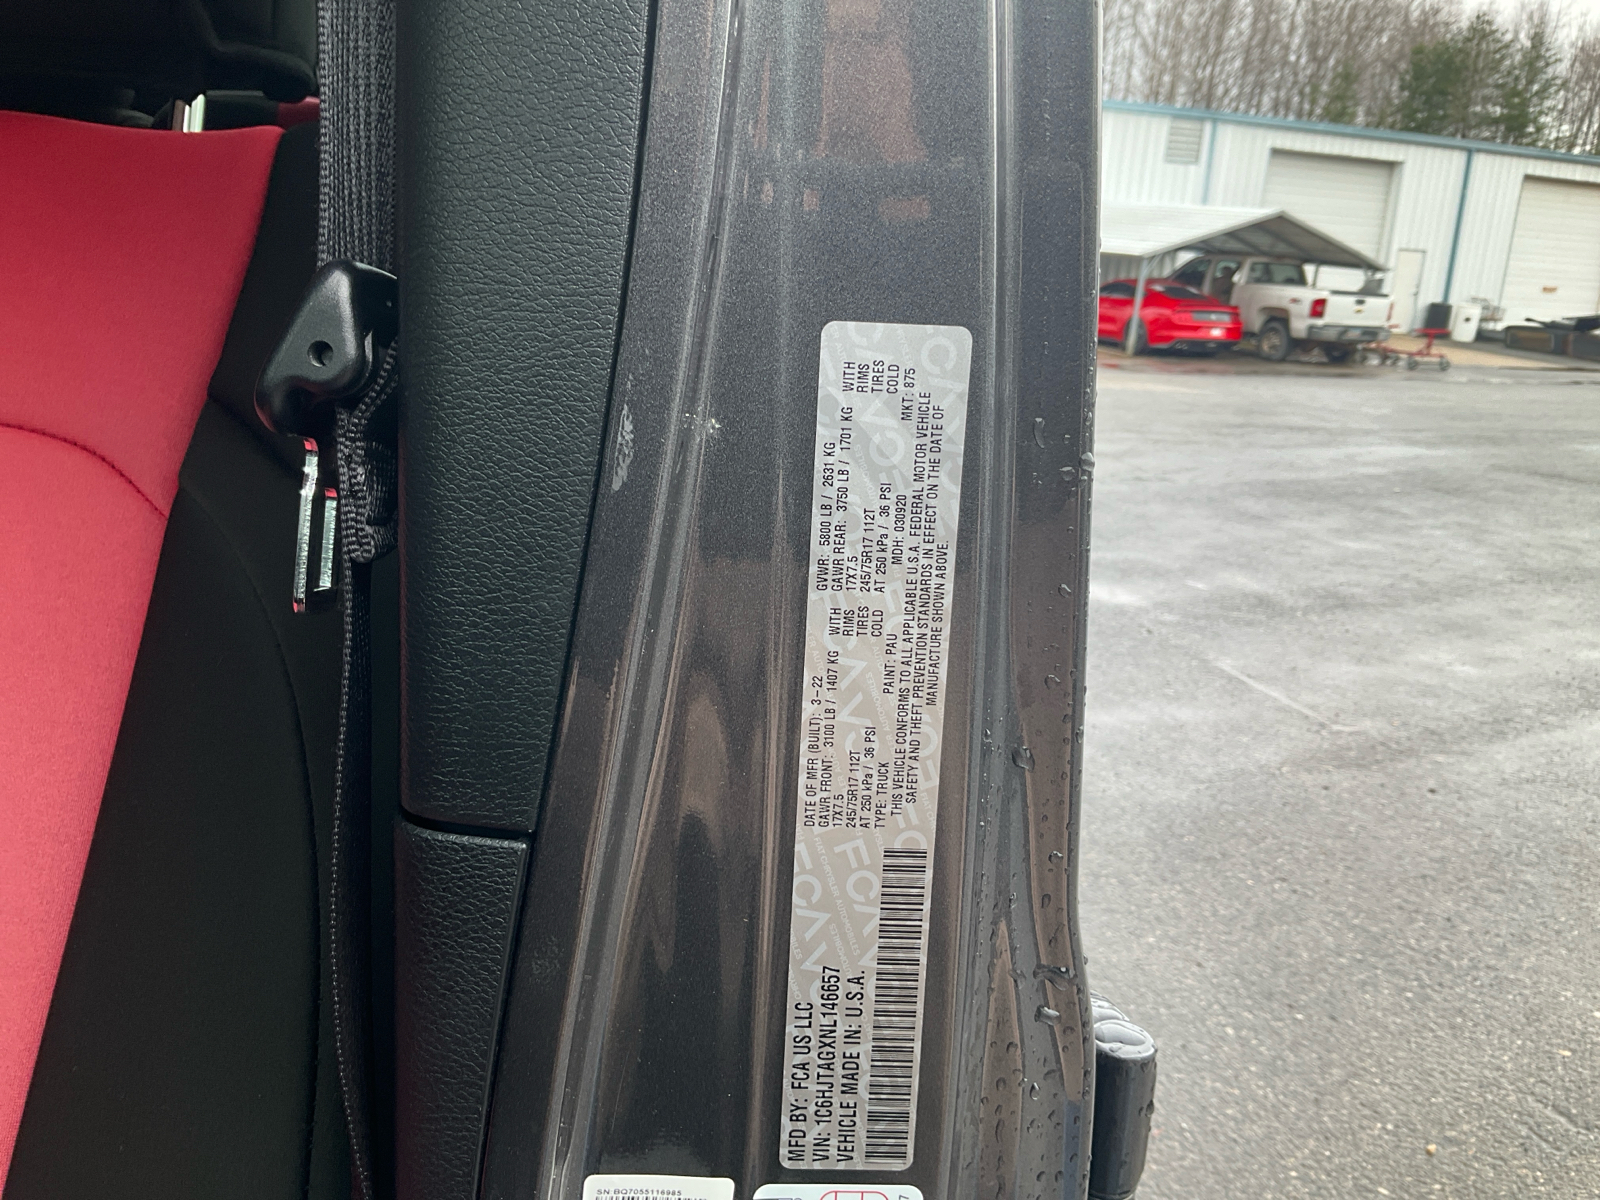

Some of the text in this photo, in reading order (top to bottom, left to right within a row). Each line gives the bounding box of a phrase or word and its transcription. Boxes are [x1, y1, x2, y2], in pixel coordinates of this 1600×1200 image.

[841, 361, 856, 392] WITH
[856, 363, 870, 393] RIMS
[870, 359, 885, 394] TIRES
[885, 364, 900, 394] COLD
[900, 367, 916, 421] MKT: 875
[840, 406, 853, 422] KG
[822, 442, 836, 457] KG
[839, 427, 852, 452] 1701
[821, 462, 835, 487] 2631
[836, 469, 849, 482] LB
[835, 486, 849, 512] 3750
[878, 482, 892, 500] PSI
[819, 503, 832, 517] LB
[878, 504, 890, 518] 36
[818, 520, 832, 546] 5800
[832, 520, 847, 554] REAR:
[875, 533, 888, 553] kPa
[890, 494, 907, 565] MDH: 030920
[859, 507, 875, 593] 245/75R17 112T
[815, 554, 830, 591] GVWR:
[830, 558, 845, 592] GAWR
[845, 555, 858, 591] 17X7.5
[874, 556, 887, 575] 250
[873, 578, 886, 593] AT
[890, 391, 931, 817] THIS VEHICLE CONFORMS TO ALL APPLICABLE U.S.A. FEDERAL MOTOR VEHICLE
[905, 404, 944, 804] SAFETY AND THEFT PREVENTION STANDARDS IN EFFECT ON THE DATE OF
[828, 607, 842, 636] WITH
[841, 609, 855, 637] RIMS
[855, 605, 869, 637] TIRES
[870, 609, 884, 637] COLD
[925, 540, 949, 706] MANUFACTURE SHOWN ABOVE.
[826, 650, 839, 664] KG
[882, 633, 898, 694] PAINT: PAU
[825, 667, 838, 692] 1407
[822, 707, 836, 721] LB
[807, 713, 823, 754] (BUILT):
[822, 723, 835, 747] 3100
[863, 726, 876, 743] PSI
[863, 746, 875, 759] 36
[805, 757, 819, 780] MFR
[819, 755, 833, 792] FRONT:
[861, 773, 873, 791] kPa
[805, 783, 817, 797] OF
[845, 749, 861, 828] 245/75R17 112T
[873, 761, 890, 829] TYPE: TRUCK
[803, 800, 816, 827] DATE
[817, 796, 831, 828] GAWR
[831, 793, 844, 827] 17X7.5
[860, 794, 872, 812] 250
[859, 815, 871, 829] AT
[811, 965, 840, 1162] VIN: 1C6HJTAGXNL146657
[836, 970, 865, 1163] VEHICLE MADE IN: U.S.A.
[787, 1001, 814, 1161] MFD BY: FCA US LLC
